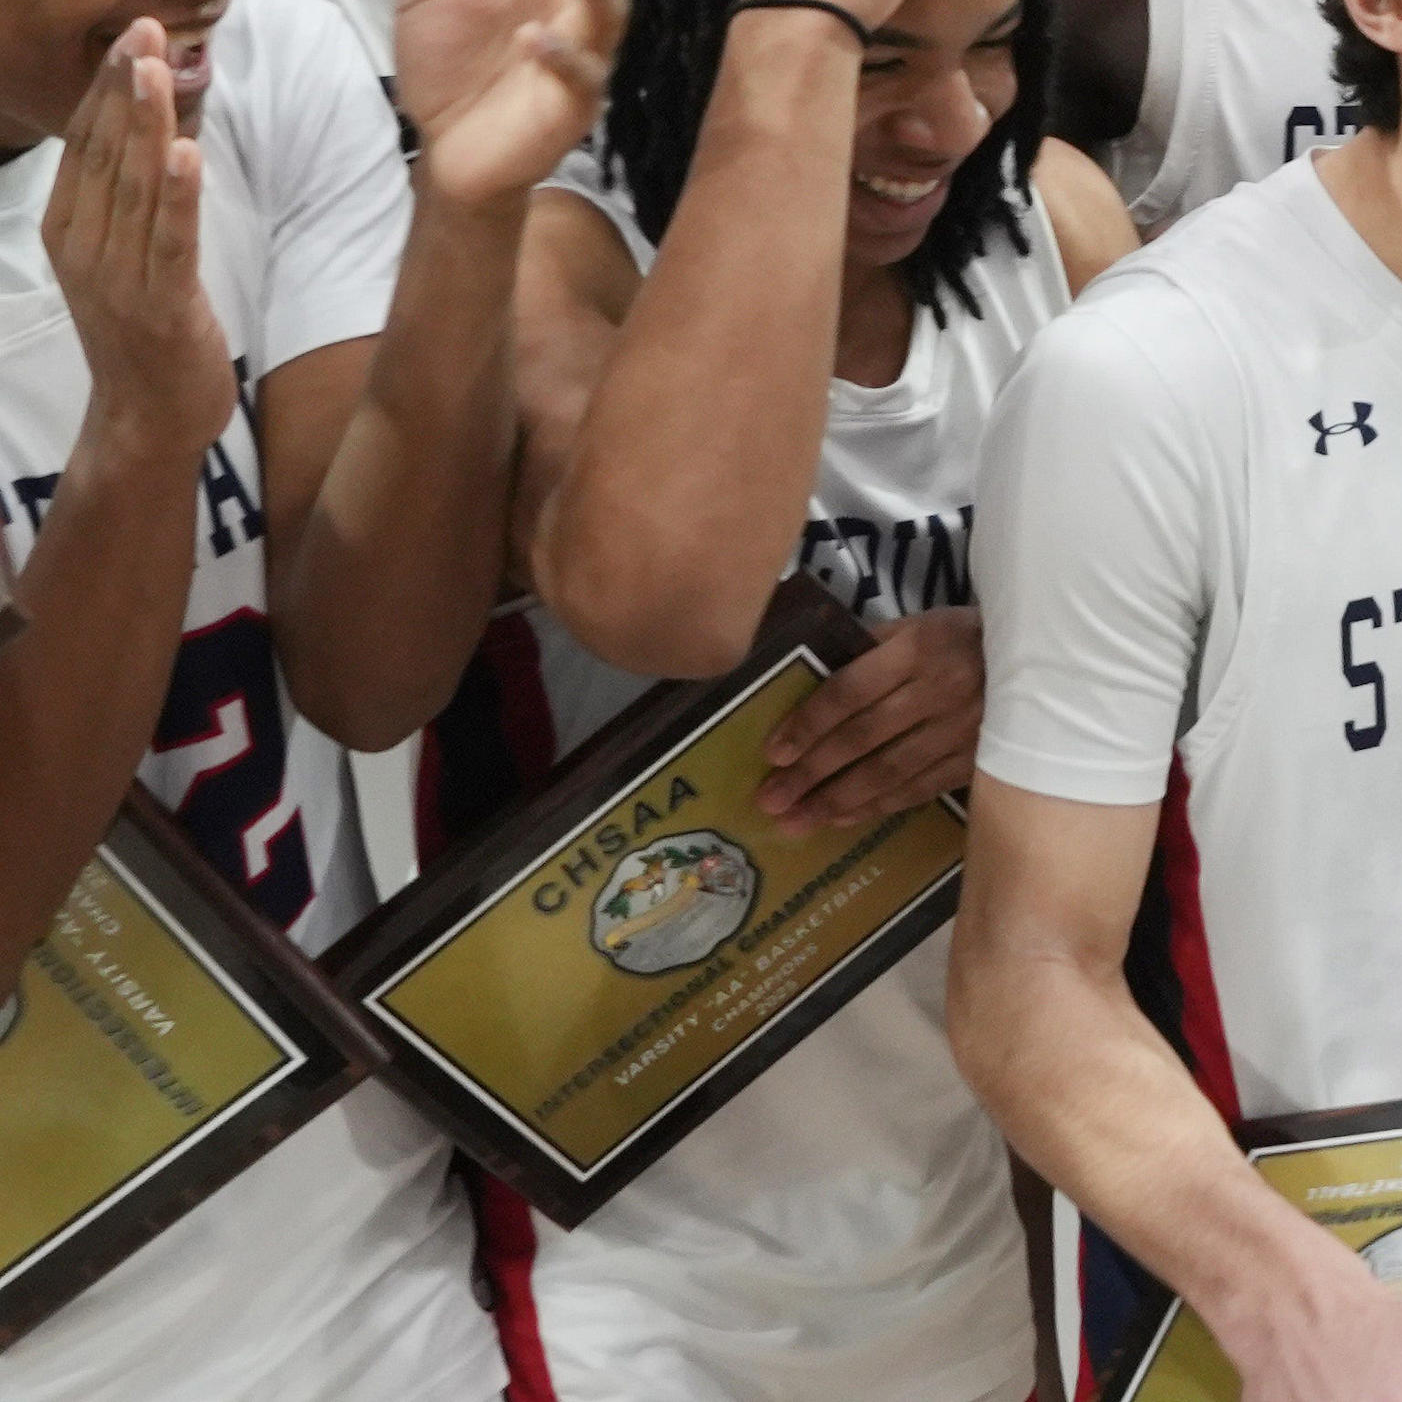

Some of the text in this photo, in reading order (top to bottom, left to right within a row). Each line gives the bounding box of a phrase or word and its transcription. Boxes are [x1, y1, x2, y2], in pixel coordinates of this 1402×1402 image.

[532, 775, 698, 915] CHSAA
[84, 950, 176, 1038] VARSITY
[613, 1012, 699, 1086] VARSITY
[755, 866, 884, 971] BASKETBALL
